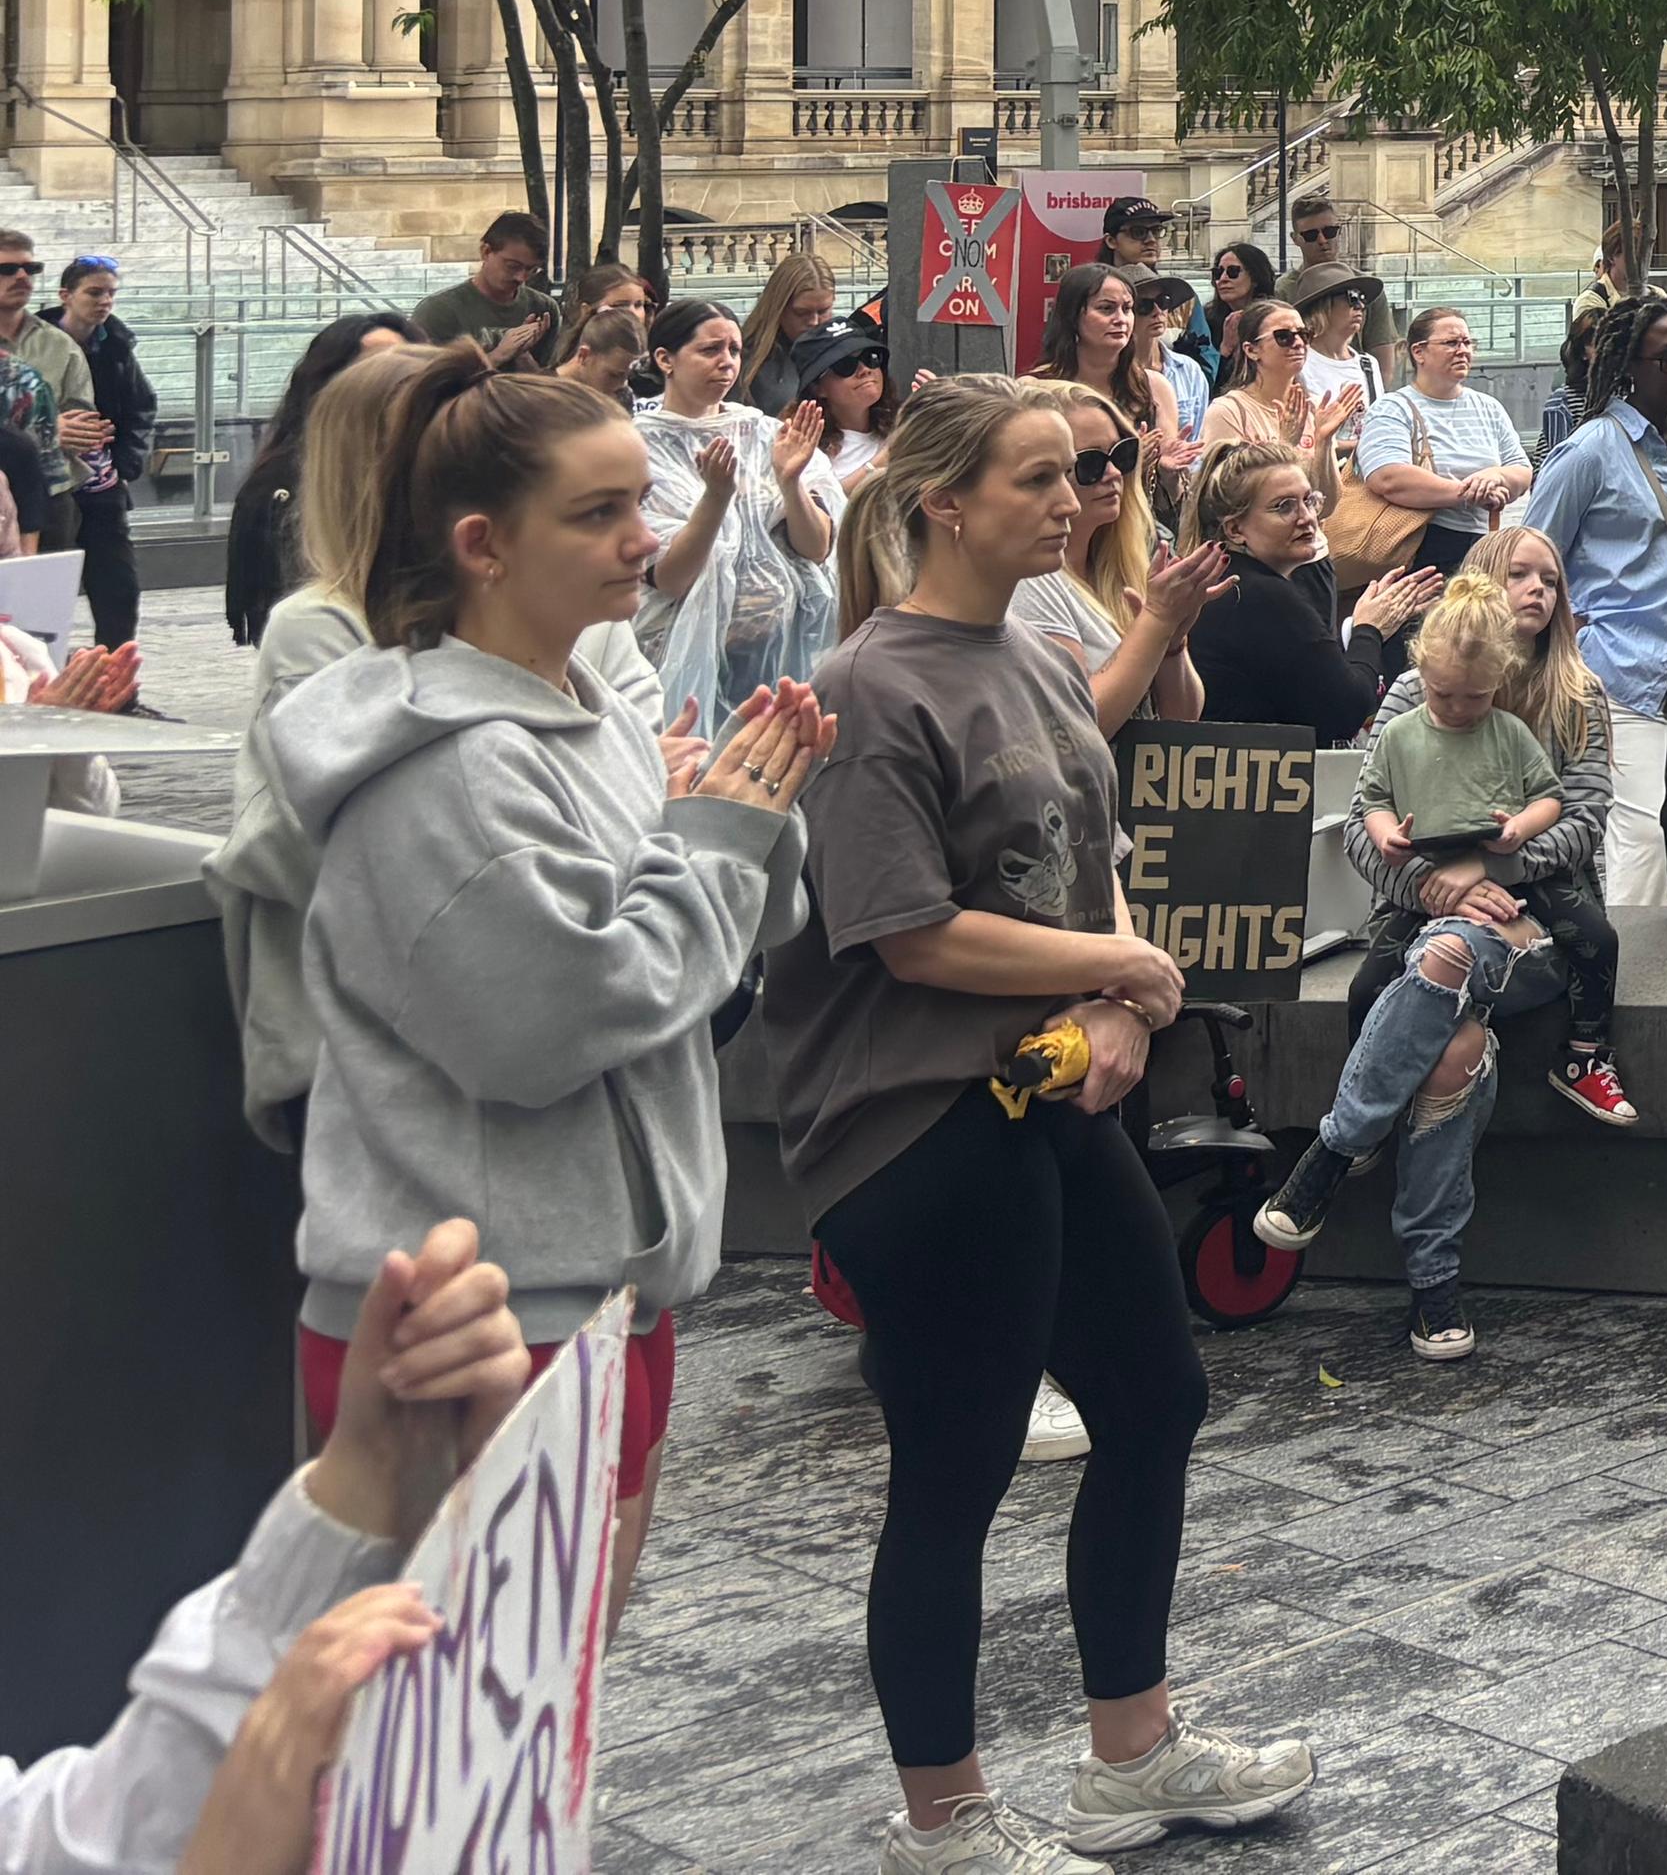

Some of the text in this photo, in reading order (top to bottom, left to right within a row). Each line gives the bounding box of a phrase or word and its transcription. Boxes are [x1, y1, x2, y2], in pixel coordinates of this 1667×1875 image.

[1046, 191, 1118, 209] brisban
[939, 239, 997, 259] CM
[954, 237, 985, 268] NO!
[949, 298, 980, 316] ON
[1131, 743, 1312, 813] RIGHTS
